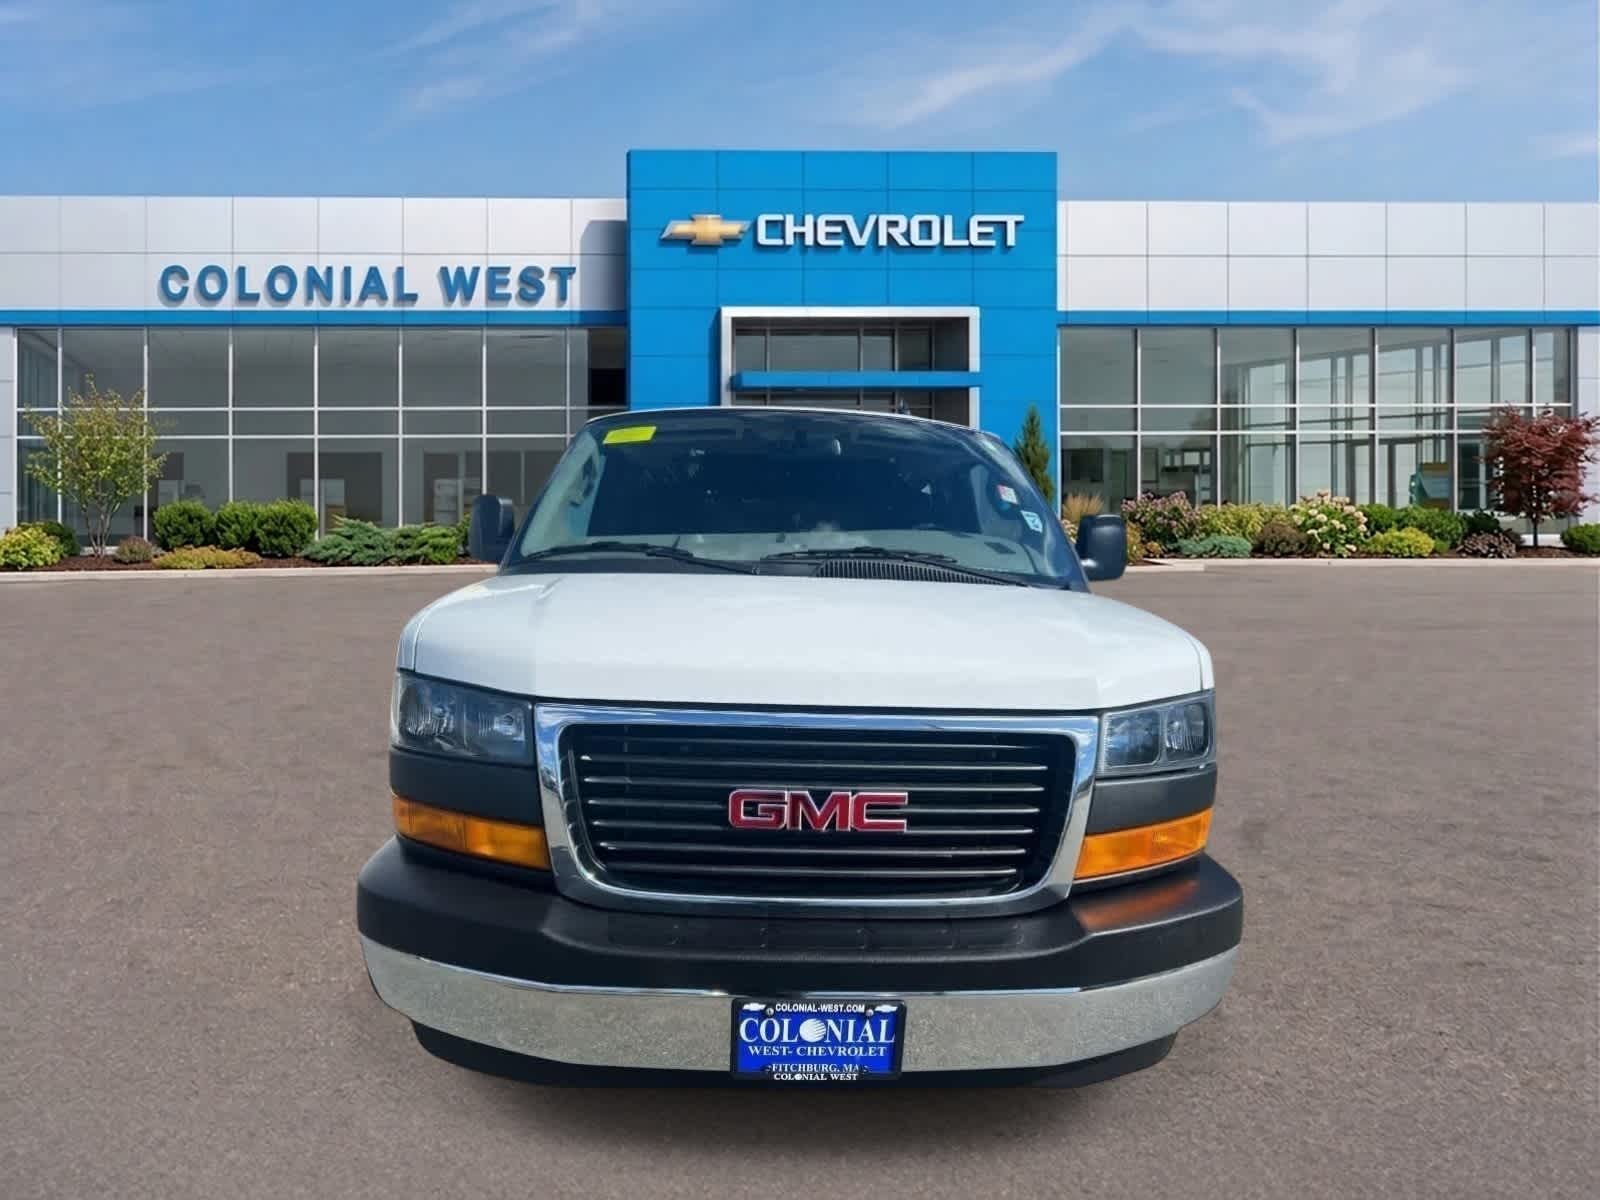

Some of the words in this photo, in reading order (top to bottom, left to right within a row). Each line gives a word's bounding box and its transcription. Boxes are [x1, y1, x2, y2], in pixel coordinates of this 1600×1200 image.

[756, 213, 1024, 247] CHEVROLET
[160, 265, 417, 305] COLONIAL
[439, 266, 577, 303] WEST
[728, 788, 909, 832] GMC
[775, 1003, 866, 1013] COLONIAL-WEST.COM
[739, 1017, 895, 1043] COLONIAL
[796, 1046, 886, 1057] CHEVROLET
[830, 1073, 859, 1081] WEST
